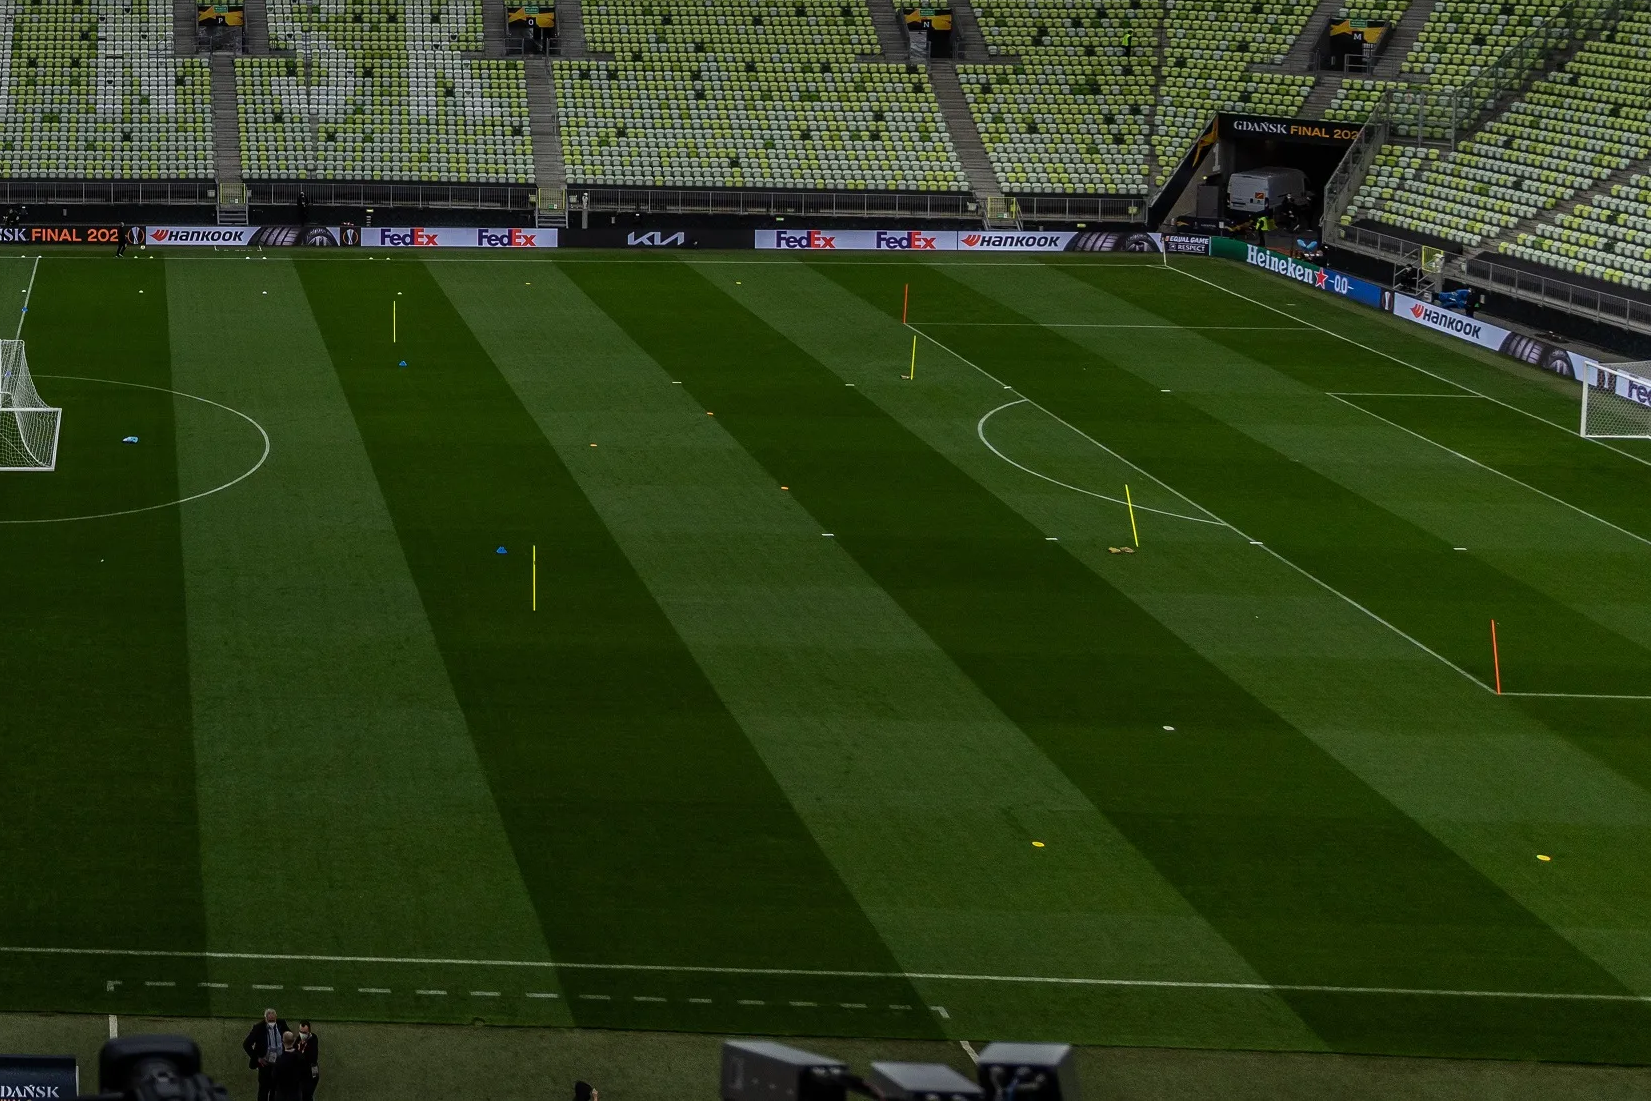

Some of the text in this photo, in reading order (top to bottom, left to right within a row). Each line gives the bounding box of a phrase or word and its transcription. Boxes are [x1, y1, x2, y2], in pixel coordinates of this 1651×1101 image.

[1353, 33, 1363, 41] M
[1233, 119, 1359, 140] GDAŃSK FINAL 202
[32, 228, 84, 242] FINAL
[87, 228, 119, 242] 202
[380, 227, 439, 245] FedEx
[478, 228, 537, 246] FedEx
[776, 230, 836, 248] FedEx
[876, 231, 936, 249] FedEx
[1178, 244, 1205, 252] RESPECT
[1246, 244, 1314, 285] Heineken
